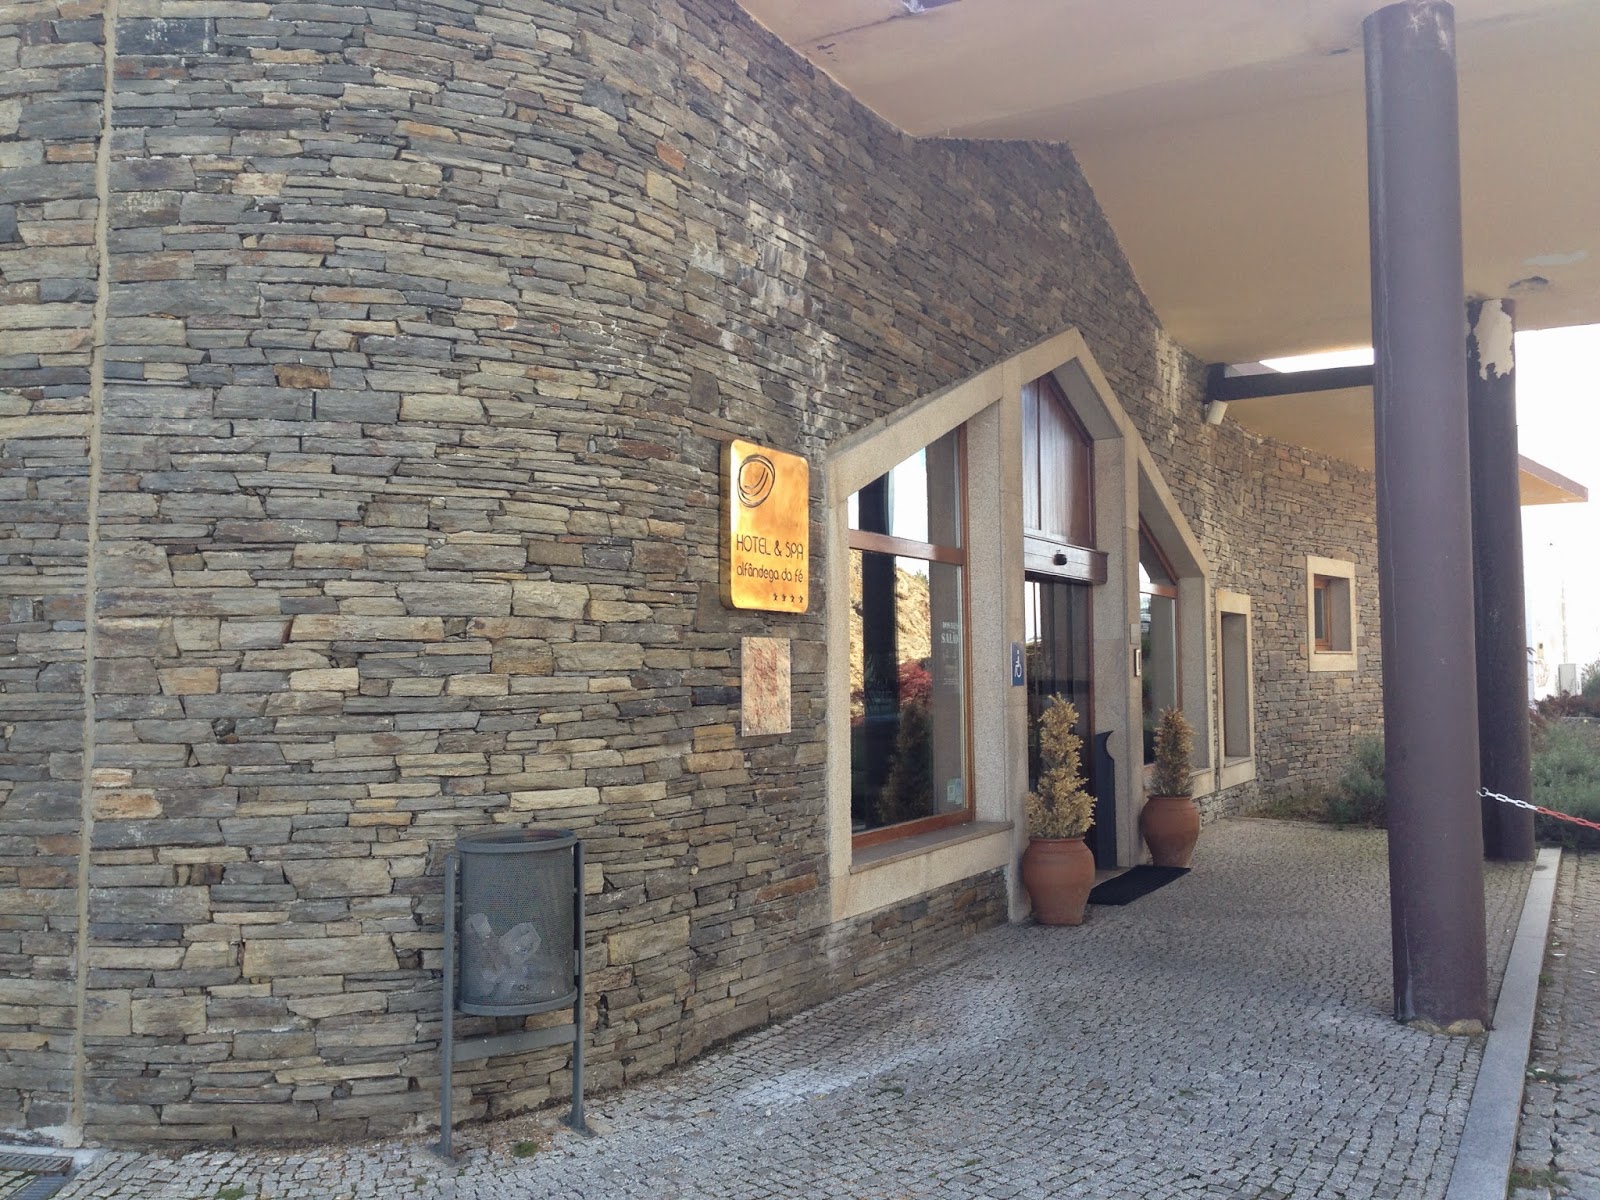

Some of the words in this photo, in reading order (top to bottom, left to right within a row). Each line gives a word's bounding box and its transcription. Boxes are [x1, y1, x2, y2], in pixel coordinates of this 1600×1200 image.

[736, 533, 771, 556] HOTEL
[774, 540, 782, 556] &
[785, 541, 804, 560] SPA
[736, 561, 779, 583] alfândega
[781, 567, 792, 582] da
[794, 569, 804, 583] fé
